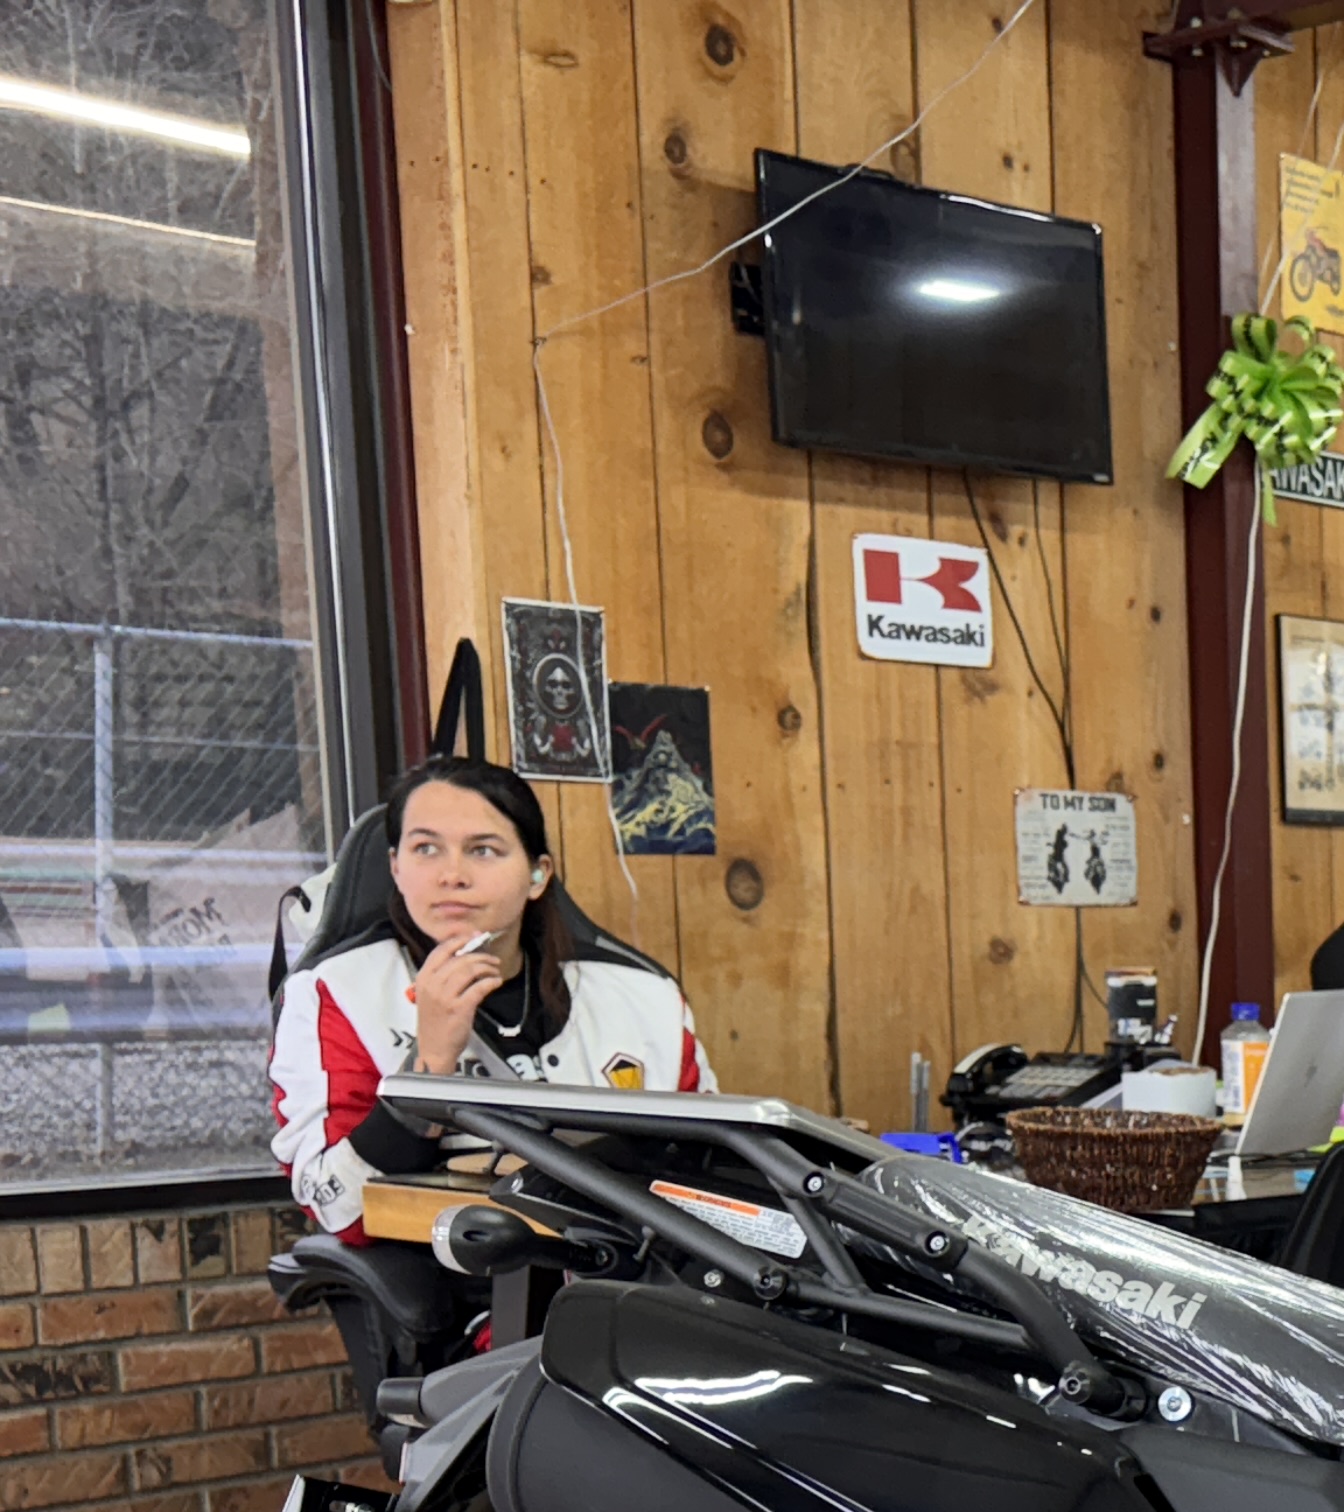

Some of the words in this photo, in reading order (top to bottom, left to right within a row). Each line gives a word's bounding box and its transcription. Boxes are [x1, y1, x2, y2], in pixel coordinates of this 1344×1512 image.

[867, 614, 985, 648] Kawasaki
[1040, 793, 1060, 811] TO
[1063, 795, 1084, 811] MY
[1088, 796, 1116, 813] SON
[962, 1215, 1208, 1330] Kawasaki
